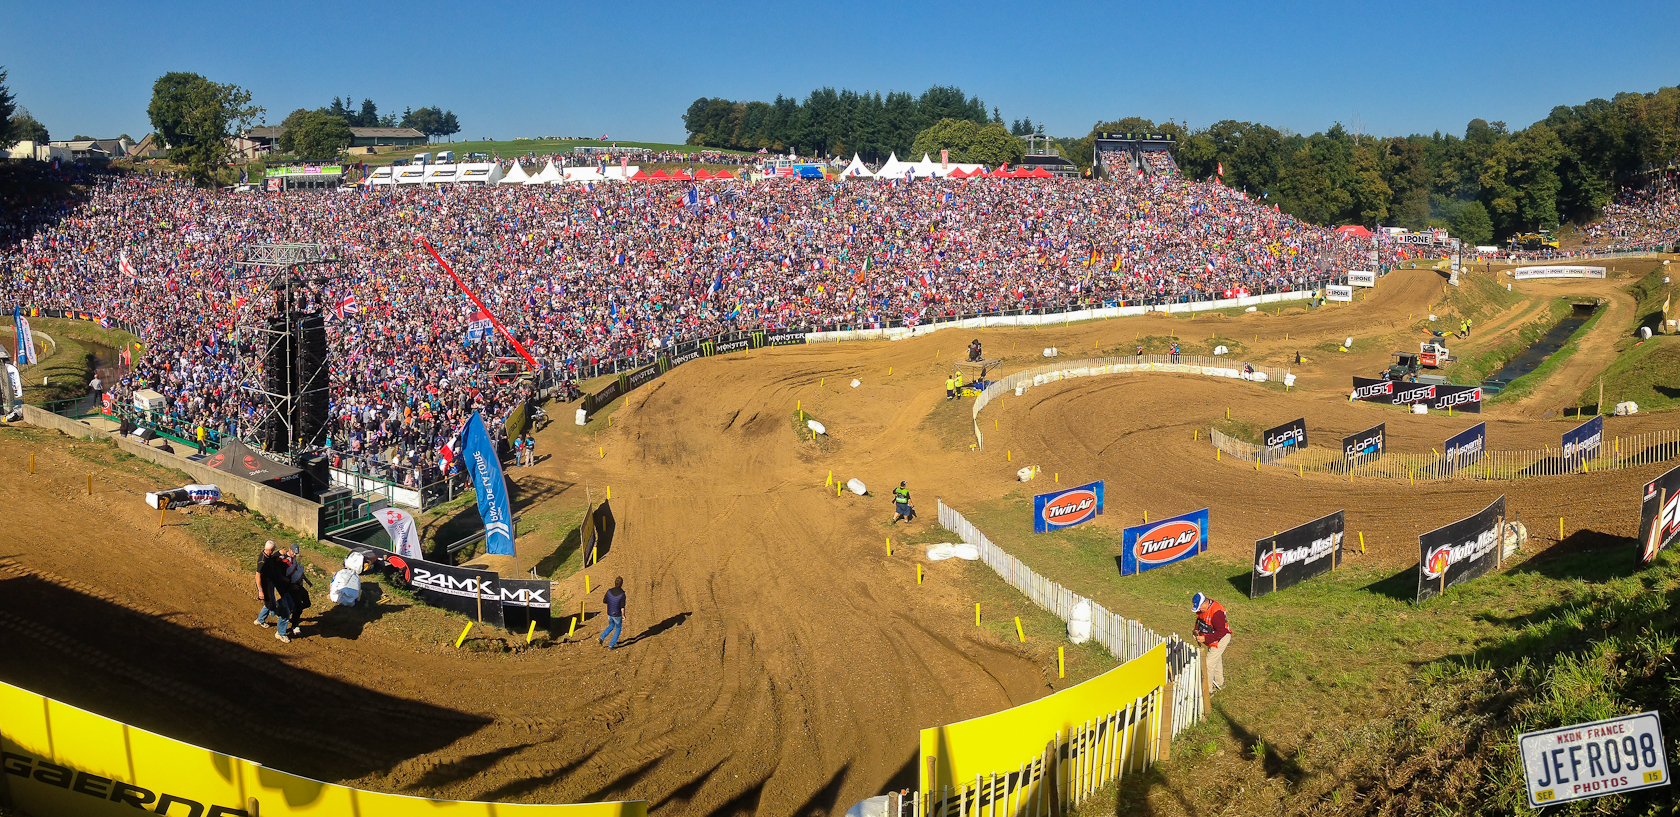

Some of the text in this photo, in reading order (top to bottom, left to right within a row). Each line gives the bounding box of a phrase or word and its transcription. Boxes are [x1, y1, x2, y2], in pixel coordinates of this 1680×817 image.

[1404, 235, 1429, 243] IPONE
[717, 340, 748, 351] MONSTER
[769, 333, 805, 342] MONSTER
[672, 351, 699, 365] MONSTER
[1356, 381, 1393, 398] JUST1
[1392, 385, 1436, 405] JUST1
[1435, 387, 1481, 410] JUST1
[1268, 428, 1303, 446] GoPro
[1346, 434, 1383, 454] GoPro
[1049, 497, 1094, 518] Twin Air
[1140, 529, 1196, 556] Twin Air
[413, 568, 495, 594] 24MX
